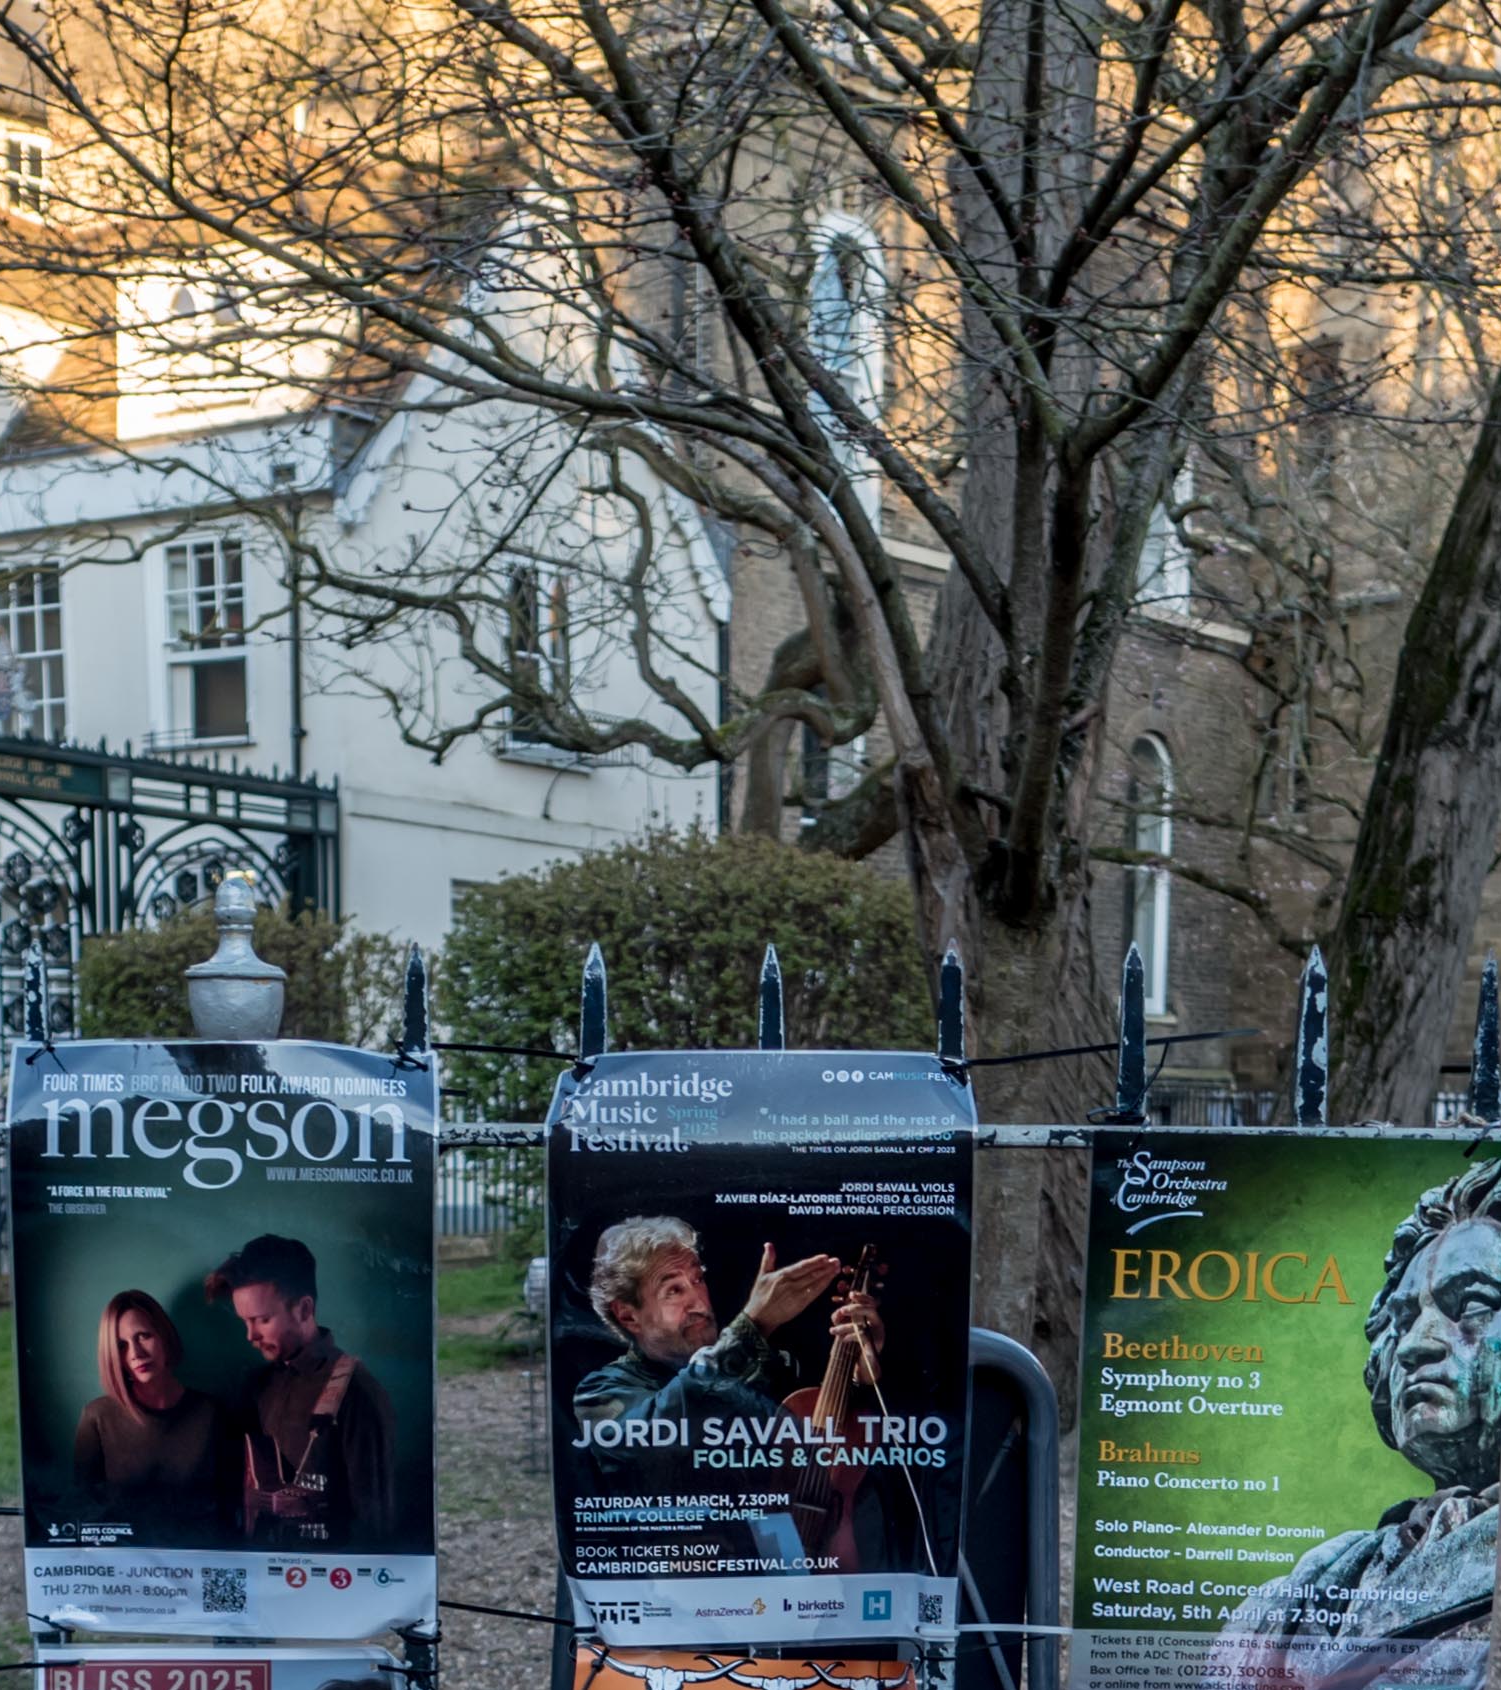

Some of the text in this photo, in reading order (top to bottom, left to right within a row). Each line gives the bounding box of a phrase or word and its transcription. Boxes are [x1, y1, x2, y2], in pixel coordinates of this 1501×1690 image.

[43, 1074, 406, 1097] FOUR TIMES BBC RADIO TWO FOLK AWARD NOMINEES
[574, 1073, 732, 1102] Cambridge
[569, 1100, 657, 1124] Music
[666, 1105, 718, 1124] Spring
[41, 1098, 411, 1189] megson
[570, 1127, 689, 1153] Festival.
[266, 1166, 413, 1184] WWW.MEGSONMUSIC.CO.UK
[1152, 1172, 1227, 1191] Orchestra
[788, 1205, 955, 1216] DAVID MAYORAL PERCUSSION
[1109, 1248, 1355, 1305] EROICA
[1102, 1333, 1264, 1363] Beethoven
[1100, 1367, 1261, 1392] Symphony no 3
[572, 1416, 948, 1448] JORDI SAVALL TRIO
[693, 1442, 947, 1470] FOLÍAS & CANARIOS
[1098, 1440, 1201, 1465] Brahms
[576, 1557, 839, 1574] CAMBRIDGEMUSICFESTIVAL.CO.UK
[1094, 1544, 1294, 1563] Conductor Darrell Davison
[33, 1566, 194, 1579] CAMBRIDGE JUNCTION
[798, 1599, 845, 1612] birketts
